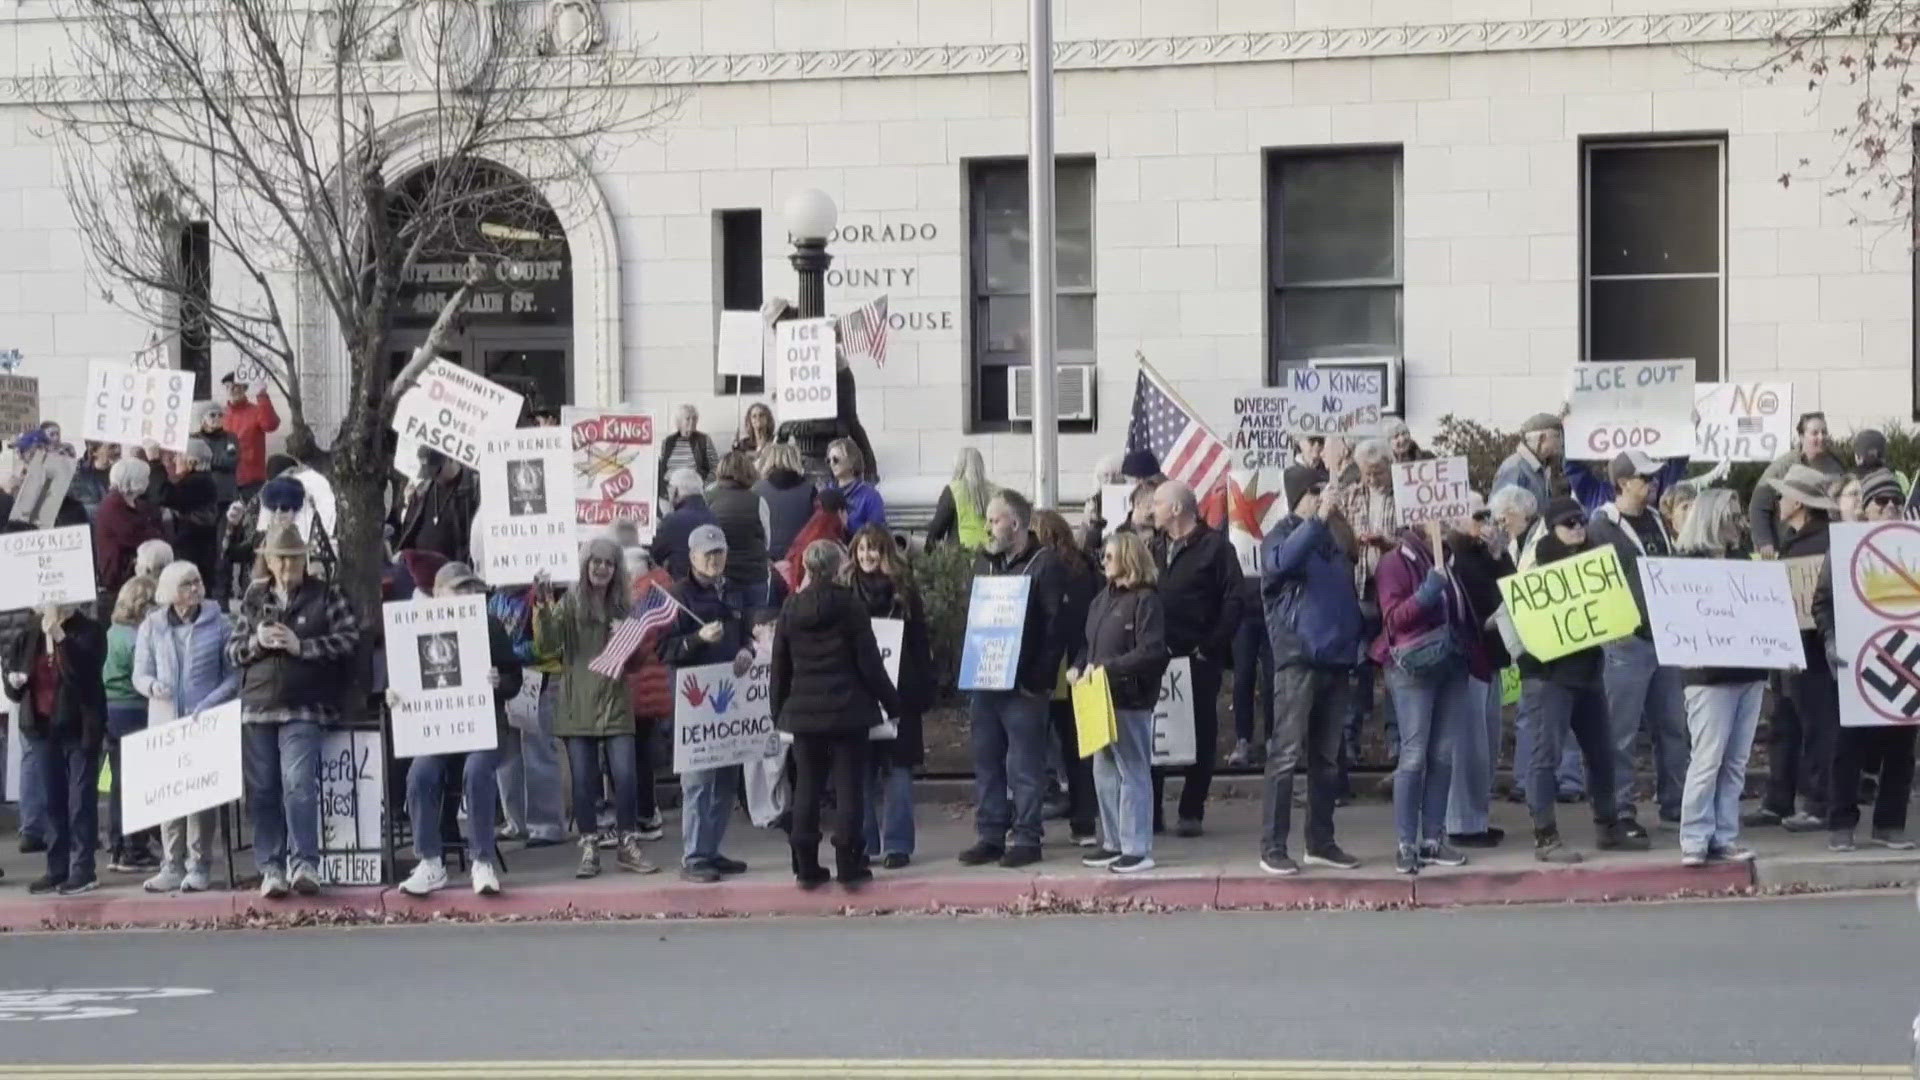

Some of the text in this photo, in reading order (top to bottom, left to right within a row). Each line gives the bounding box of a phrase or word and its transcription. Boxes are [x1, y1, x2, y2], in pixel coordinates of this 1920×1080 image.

[827, 268, 915, 287] OUNTY
[791, 325, 820, 341] ICE
[787, 347, 821, 362] OUT
[790, 366, 821, 382] FOR
[1294, 371, 1379, 395] NO KINGS
[1574, 365, 1684, 391] ICE OUT
[785, 387, 832, 402] GOOD
[1234, 398, 1288, 413] DIVERSIT
[1322, 396, 1343, 412] NO
[1240, 415, 1282, 428] MAKES
[1287, 404, 1378, 433] COLONIES
[405, 416, 481, 468] FASCIS
[573, 417, 651, 451] NO KINGS
[1588, 427, 1661, 453] GOOD
[1703, 422, 1778, 460] King
[1243, 452, 1287, 469] GREAT
[604, 473, 632, 499] NO
[1401, 461, 1449, 486] ICE
[1416, 480, 1468, 504] OUT!
[1509, 553, 1625, 616] ABOLISH
[1551, 598, 1608, 646] ICE
[746, 684, 769, 702] OU
[146, 714, 220, 751] HISTORY
[682, 713, 774, 746] DEMOCRAC
[145, 771, 220, 805] WATCHING
